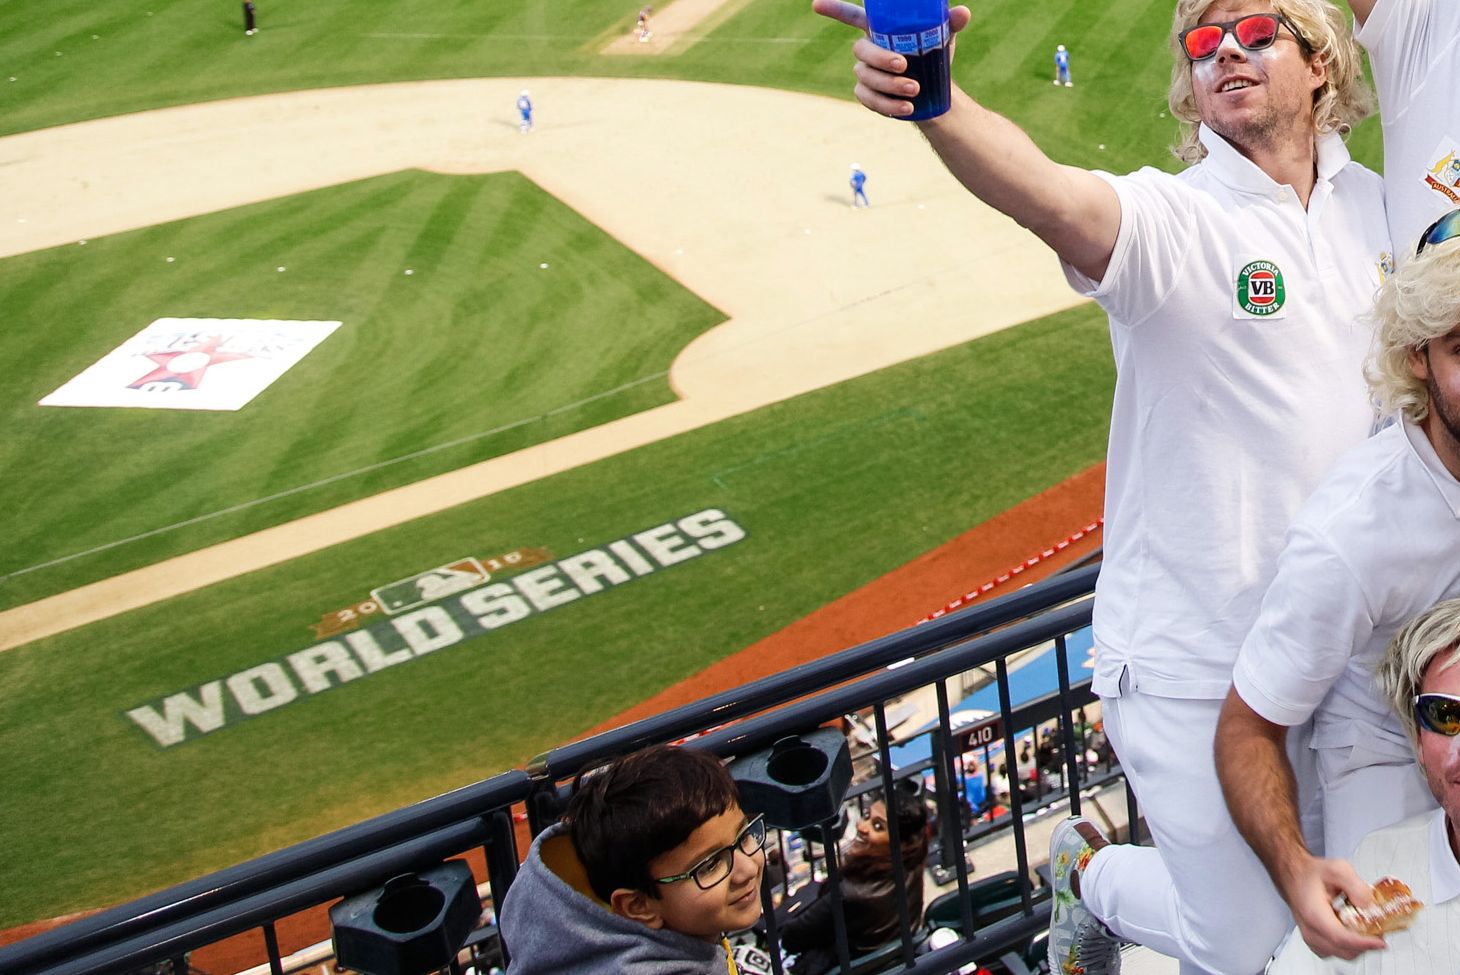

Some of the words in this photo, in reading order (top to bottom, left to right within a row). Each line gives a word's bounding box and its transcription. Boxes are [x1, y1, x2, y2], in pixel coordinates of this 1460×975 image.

[1241, 261, 1279, 276] VICTORIA
[1250, 280, 1275, 296] VB
[1244, 302, 1280, 314] BITTER
[126, 604, 466, 748] WORLD
[460, 507, 748, 629] SERIES
[968, 726, 993, 747] 410
